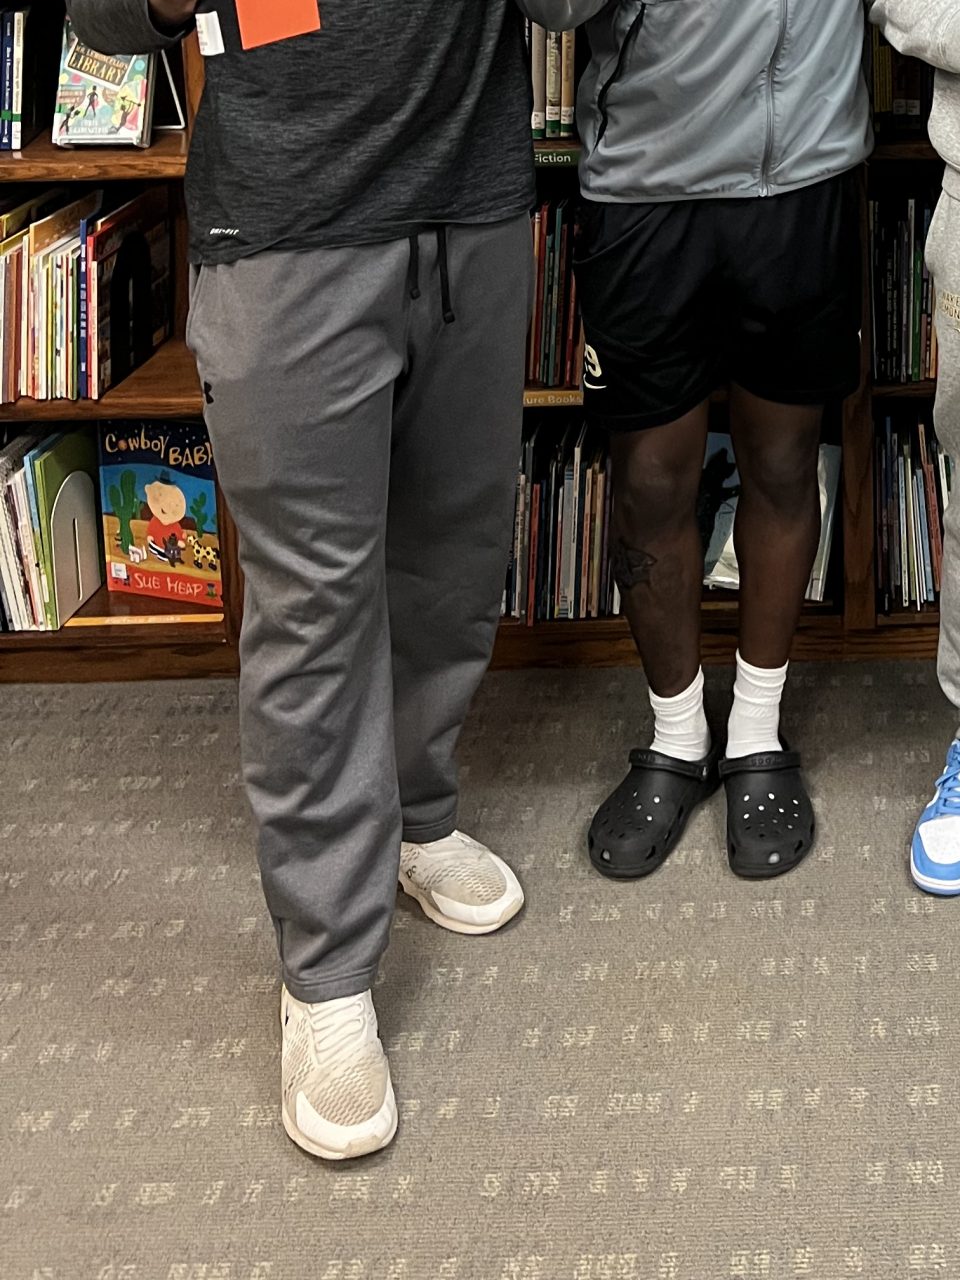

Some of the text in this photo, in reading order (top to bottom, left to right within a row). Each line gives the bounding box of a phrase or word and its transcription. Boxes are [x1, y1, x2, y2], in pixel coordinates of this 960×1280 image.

[69, 52, 126, 85] LIBRARY
[105, 425, 170, 460] Cowboy
[133, 572, 204, 598] SUE HEAP
